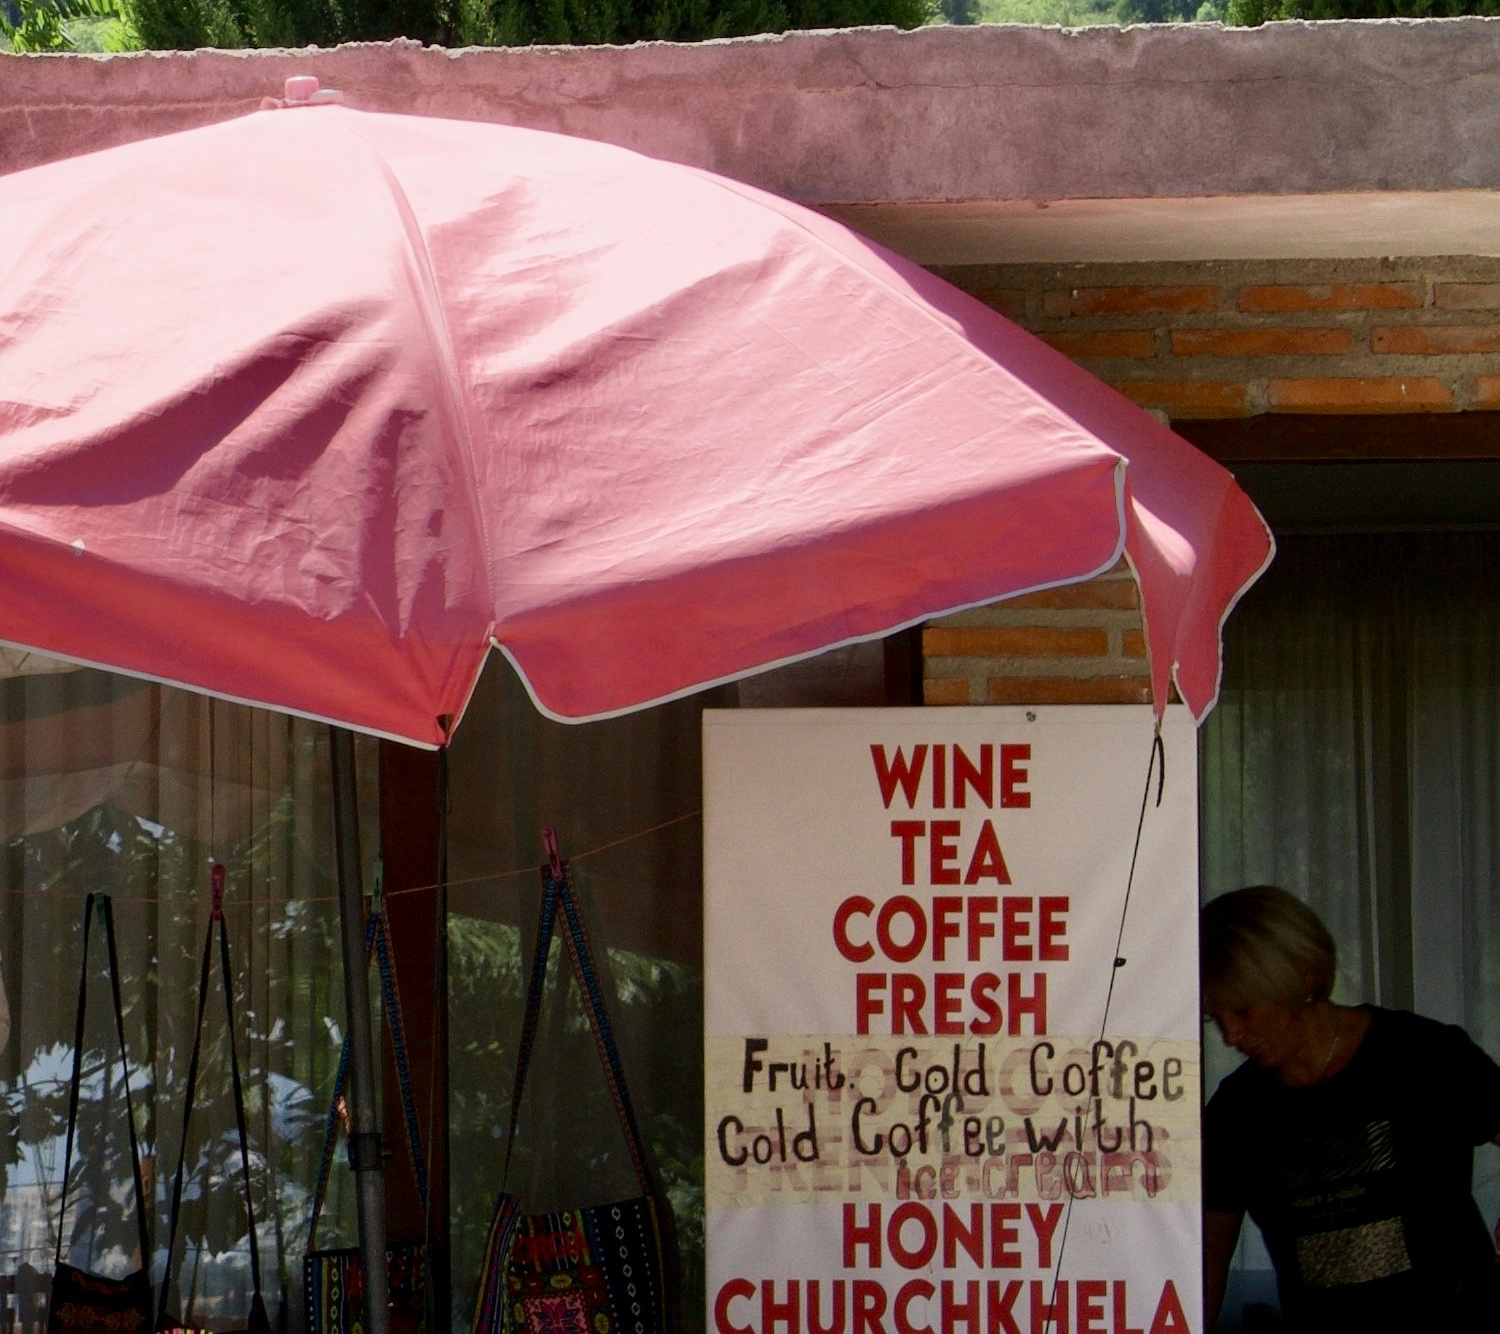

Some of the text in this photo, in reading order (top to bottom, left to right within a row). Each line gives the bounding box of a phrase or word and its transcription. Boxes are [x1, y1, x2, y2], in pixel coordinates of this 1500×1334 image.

[870, 744, 1031, 809] WINE
[891, 820, 1011, 885] TEA
[832, 895, 1070, 962] COFFEE
[856, 972, 1047, 1035] FRESH
[895, 1042, 990, 1097] Cold
[1030, 1040, 1185, 1102] Coffee
[716, 1107, 820, 1167] Cold
[851, 1093, 1006, 1158] Coffee
[1024, 1098, 1154, 1155] with
[842, 1202, 1065, 1269] HONEY
